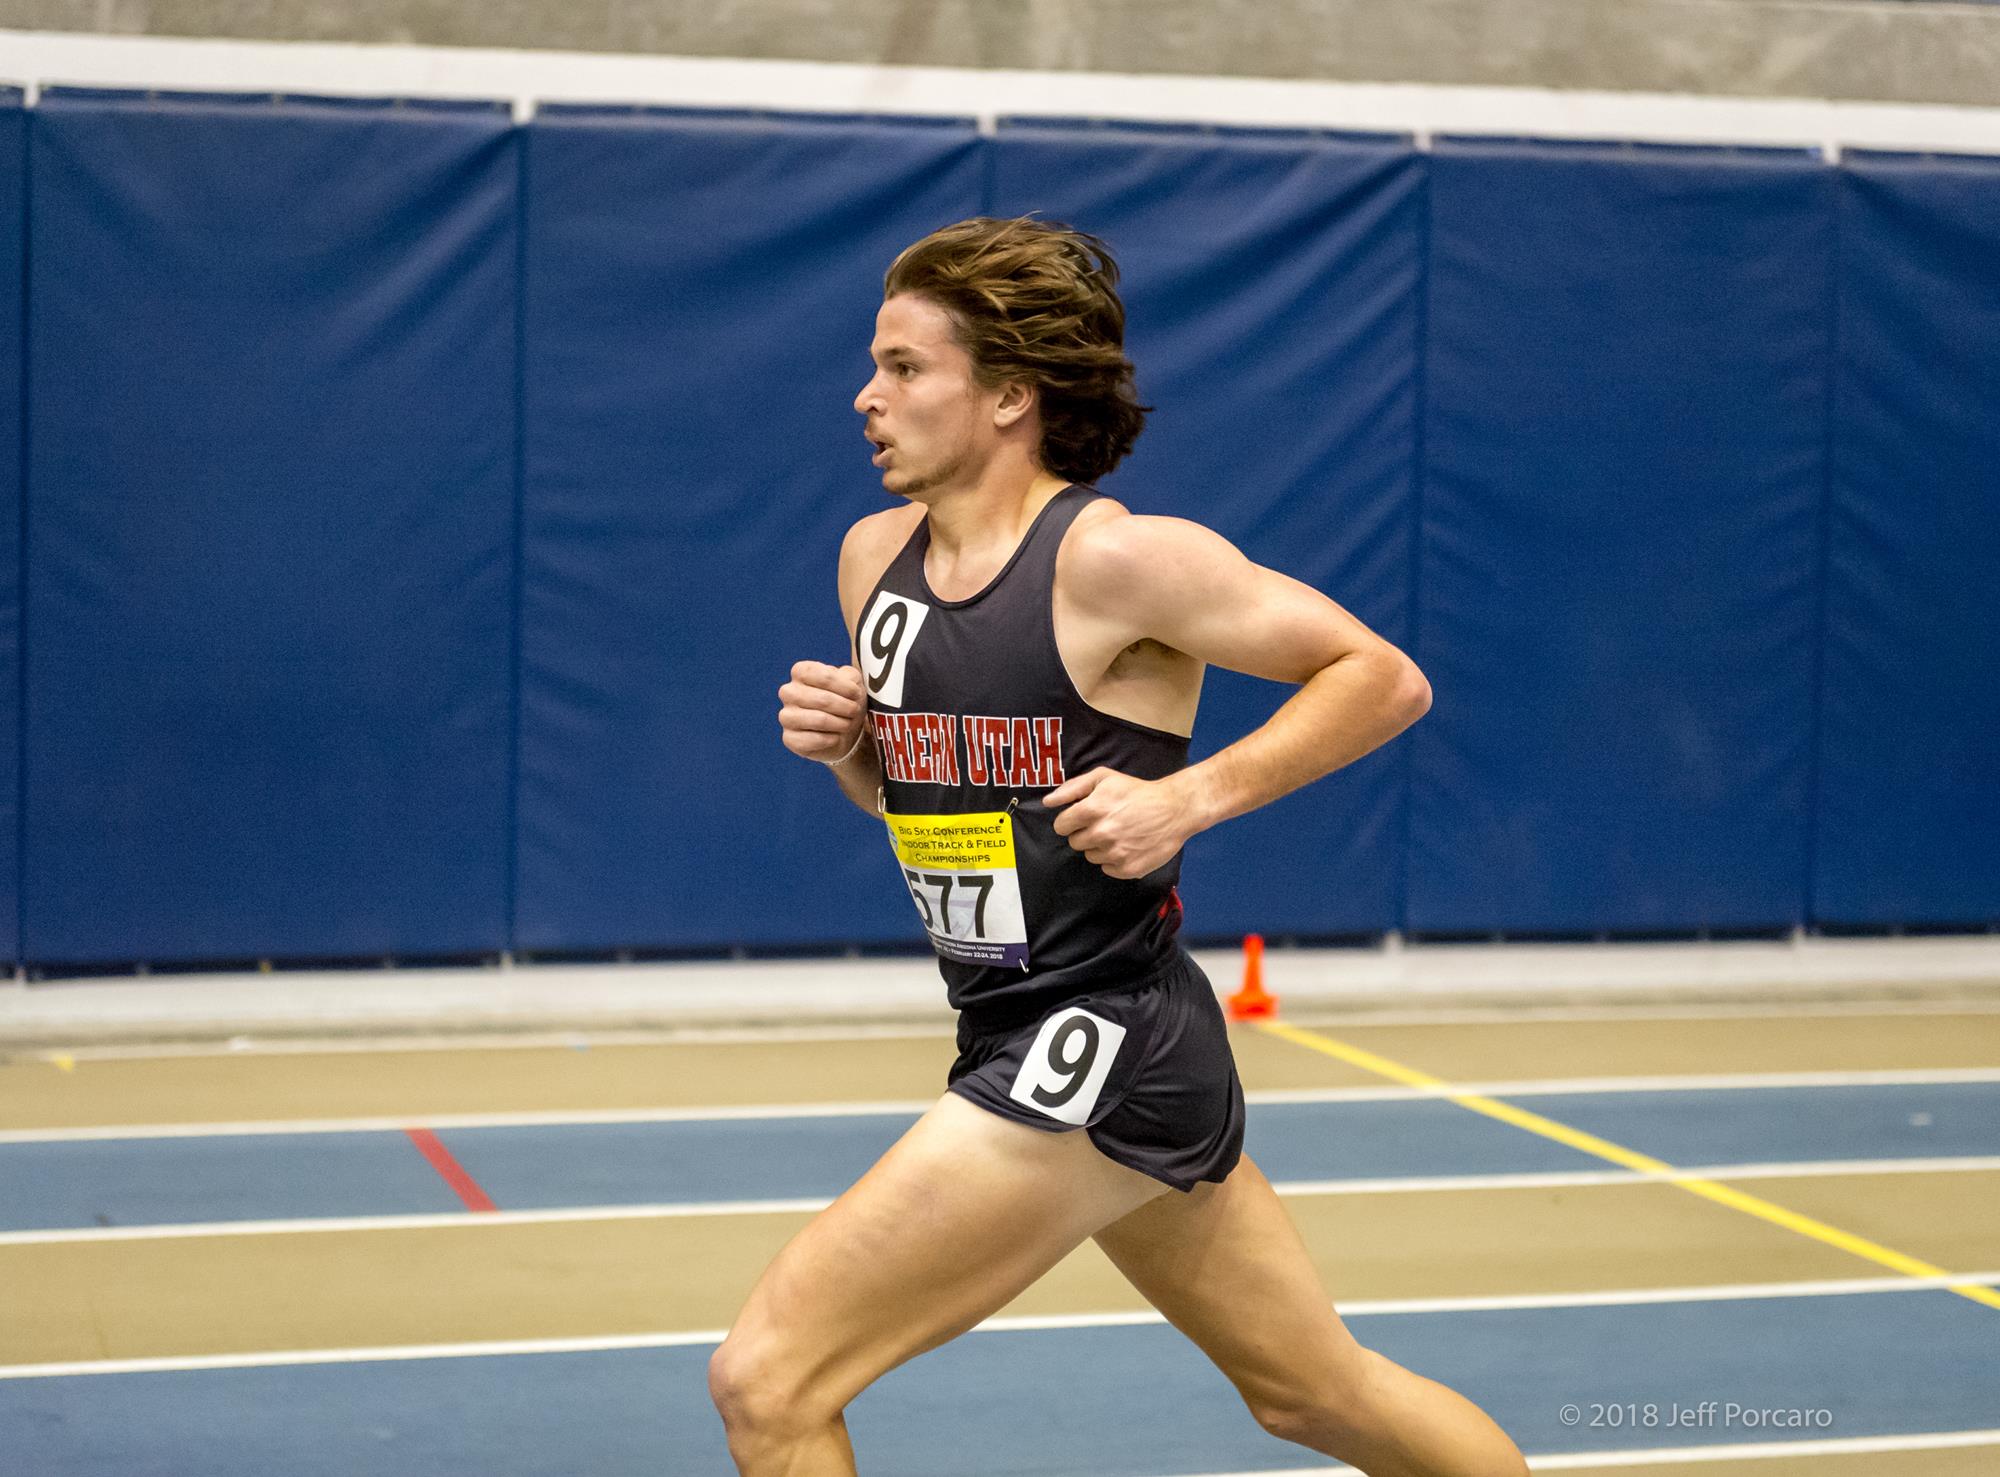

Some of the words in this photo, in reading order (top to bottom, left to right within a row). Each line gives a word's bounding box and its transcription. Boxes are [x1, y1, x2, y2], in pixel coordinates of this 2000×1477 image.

[868, 601, 908, 693] 9
[869, 710, 960, 787] THERN
[963, 715, 1066, 788] UTAH
[898, 826, 912, 835] BIG
[914, 827, 930, 836] SKY
[933, 825, 1003, 836] CONFERENCE
[915, 853, 991, 863] CHAMPIONSHIPS
[931, 840, 964, 849] TRACK
[966, 839, 975, 849] &
[976, 839, 1007, 848] FIELD
[904, 868, 994, 939] 577
[1030, 1015, 1100, 1108] 9
